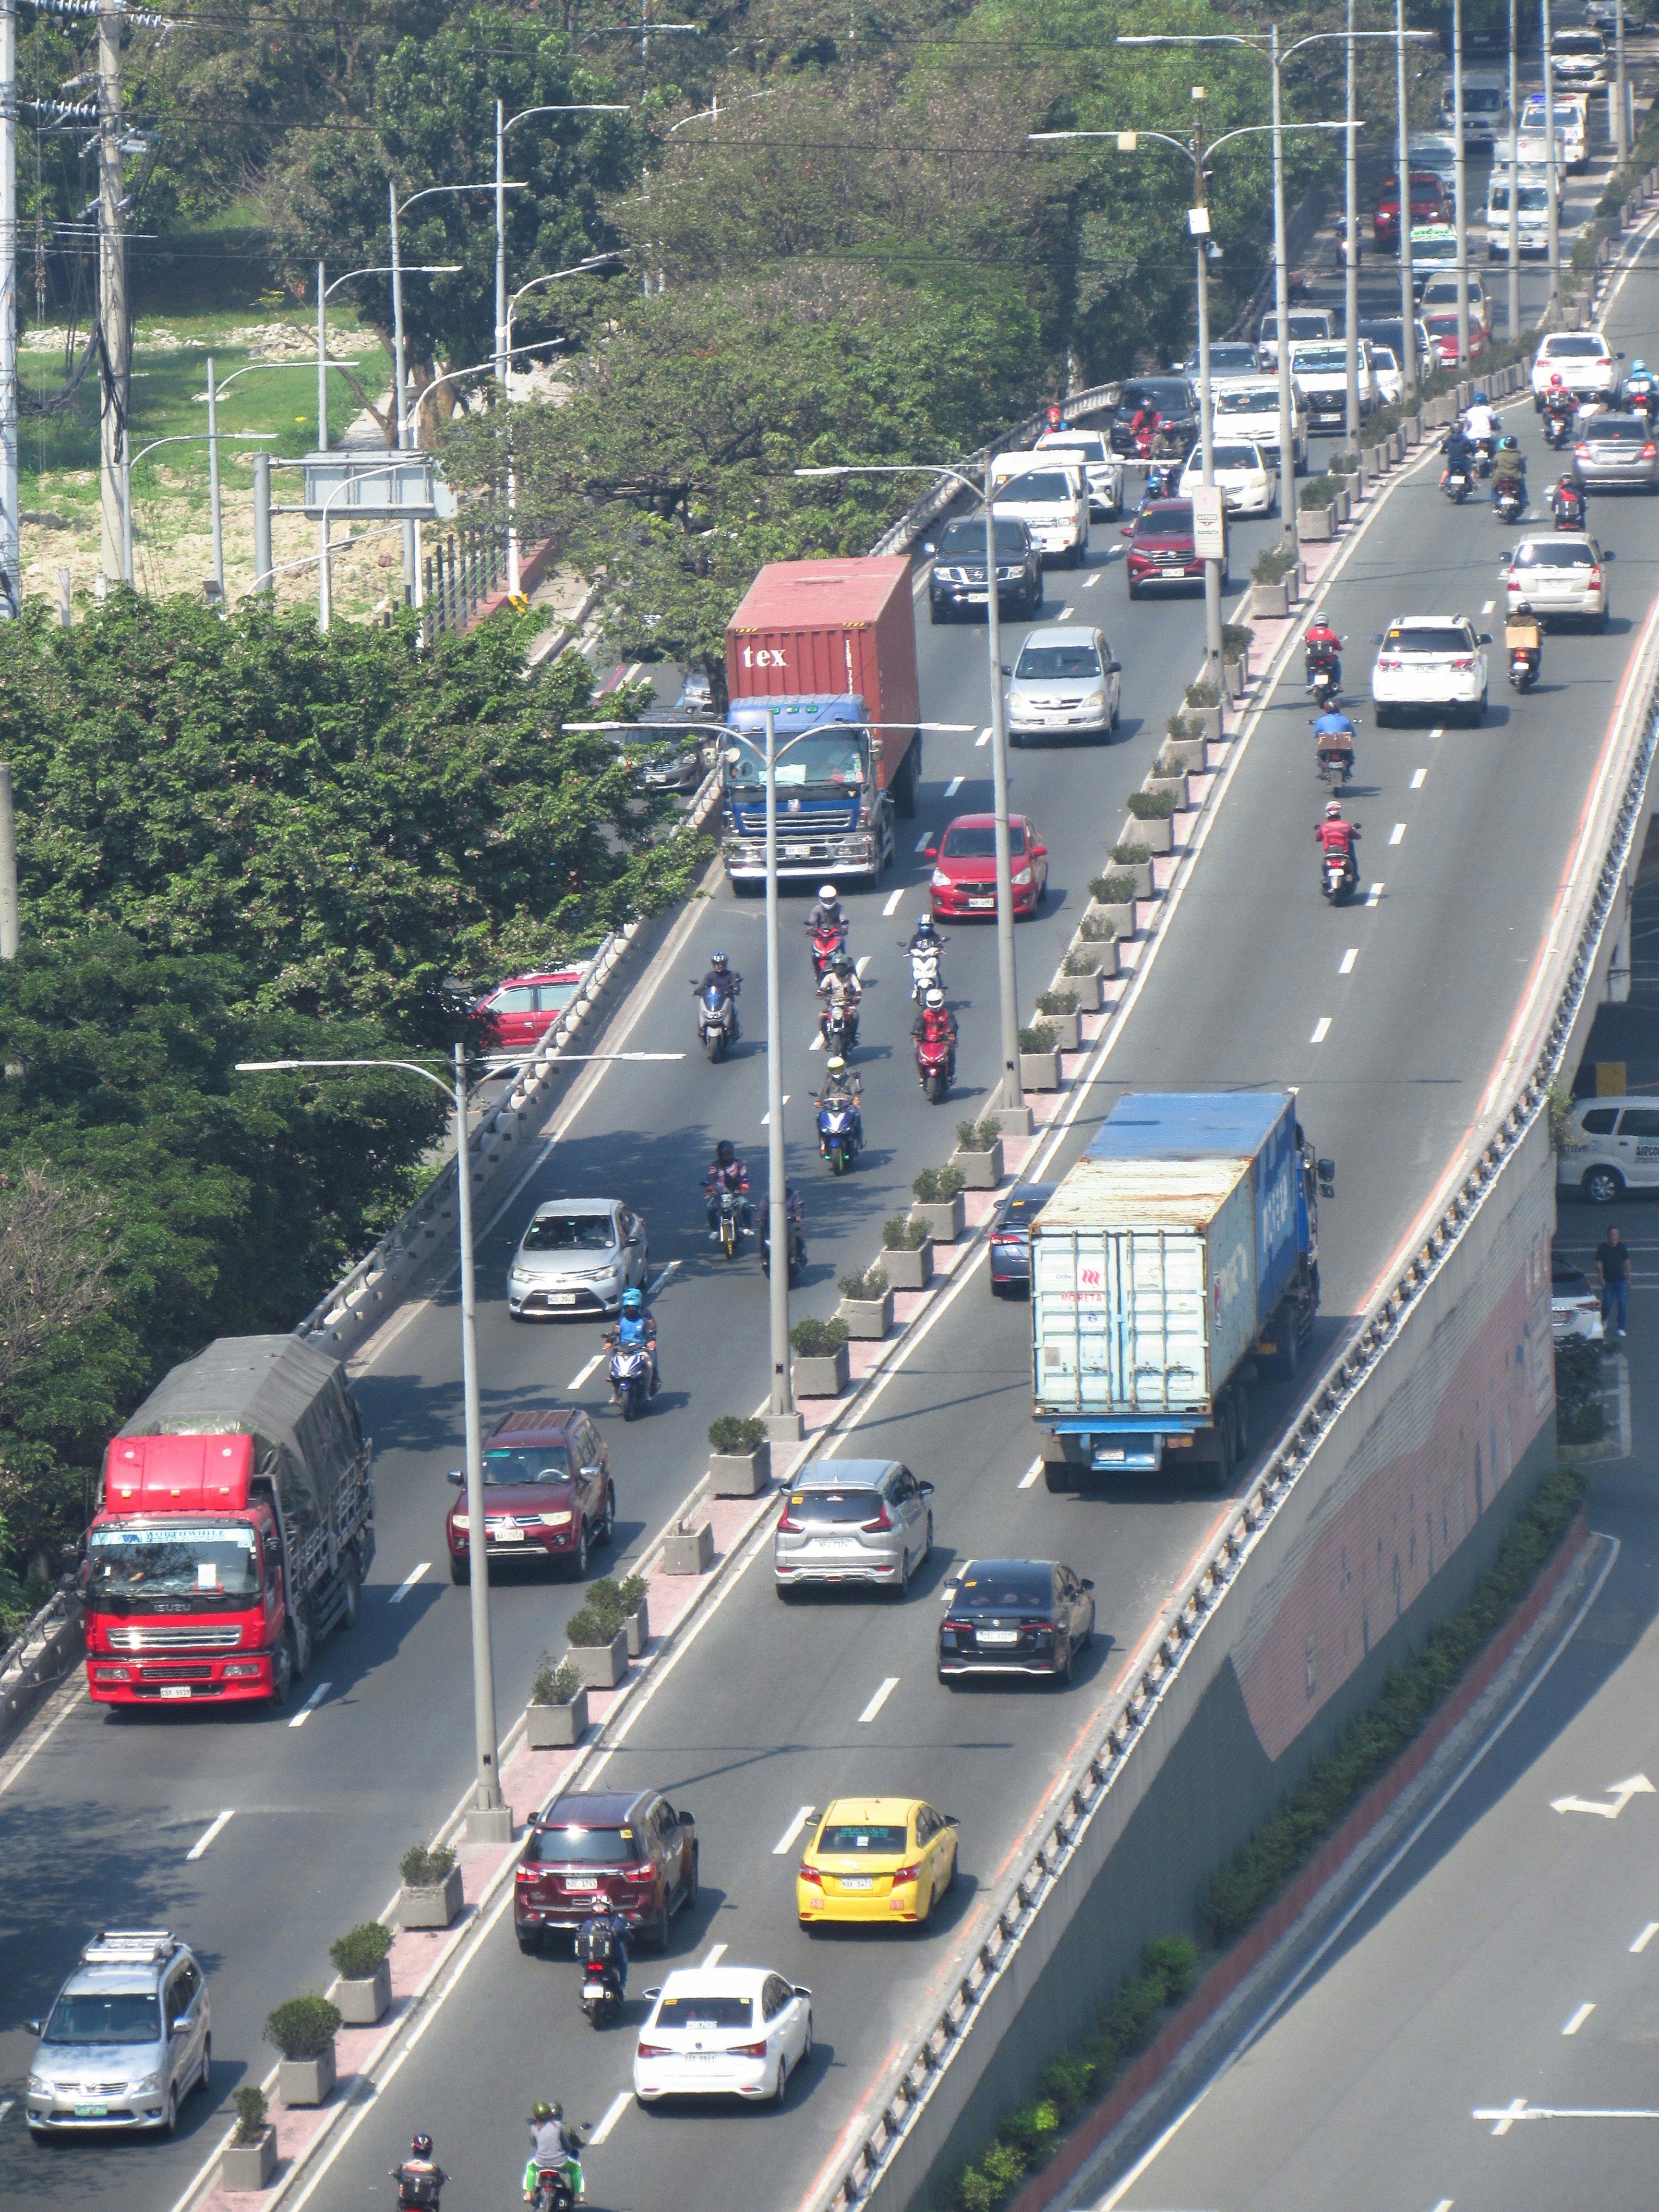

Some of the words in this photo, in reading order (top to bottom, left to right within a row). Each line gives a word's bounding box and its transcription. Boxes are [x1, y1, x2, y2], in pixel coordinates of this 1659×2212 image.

[743, 645, 788, 668] tex
[1636, 1145, 1659, 1156] AIRCO
[1061, 1293, 1102, 1302] MORETA
[154, 1604, 191, 1612] ISUZU
